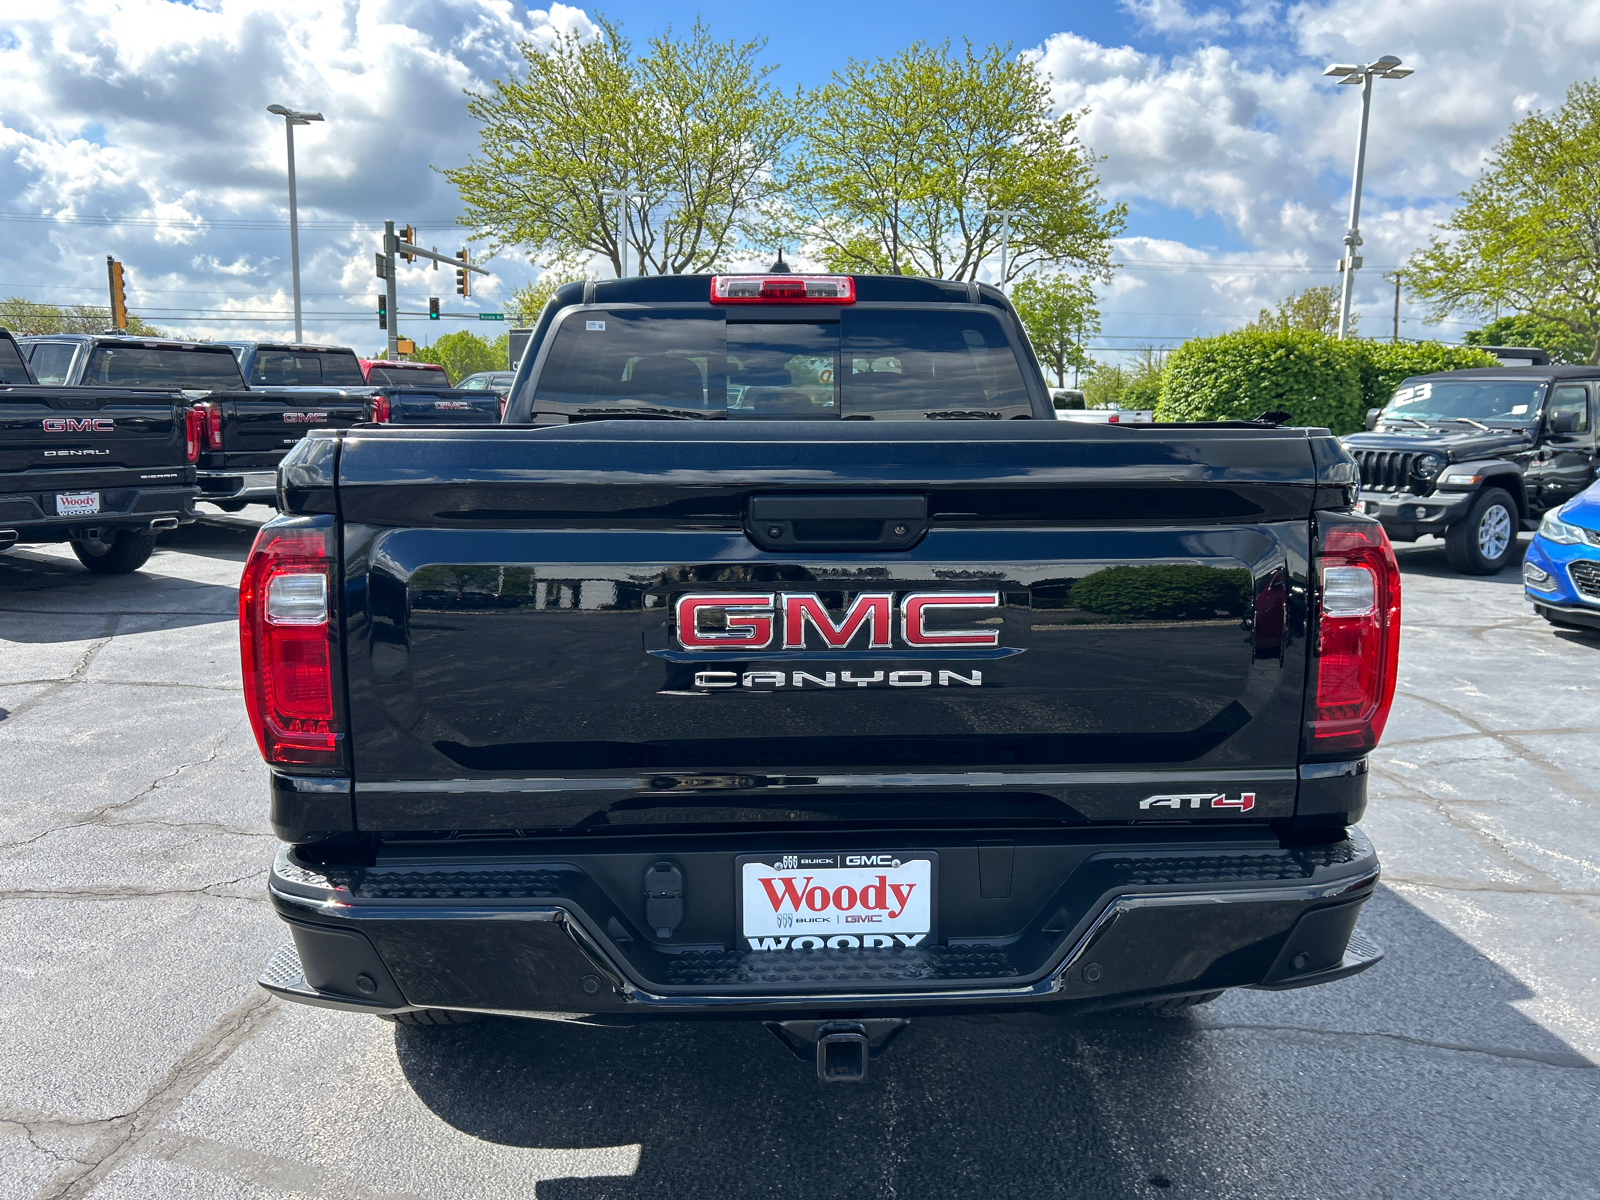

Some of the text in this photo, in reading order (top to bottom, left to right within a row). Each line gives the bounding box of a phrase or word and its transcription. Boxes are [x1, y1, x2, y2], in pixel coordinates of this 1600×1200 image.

[1394, 382, 1432, 408] 23
[42, 418, 114, 433] GMC
[283, 412, 328, 423] GMC
[43, 449, 110, 457] DENALI
[60, 496, 96, 507] Woody
[675, 590, 1000, 650] GMC
[694, 670, 982, 688] CANYON
[1139, 792, 1256, 812] AT4
[845, 855, 893, 866] GMC
[757, 875, 917, 919] Woody
[845, 914, 883, 924] GMC
[747, 934, 927, 951] WOODY
